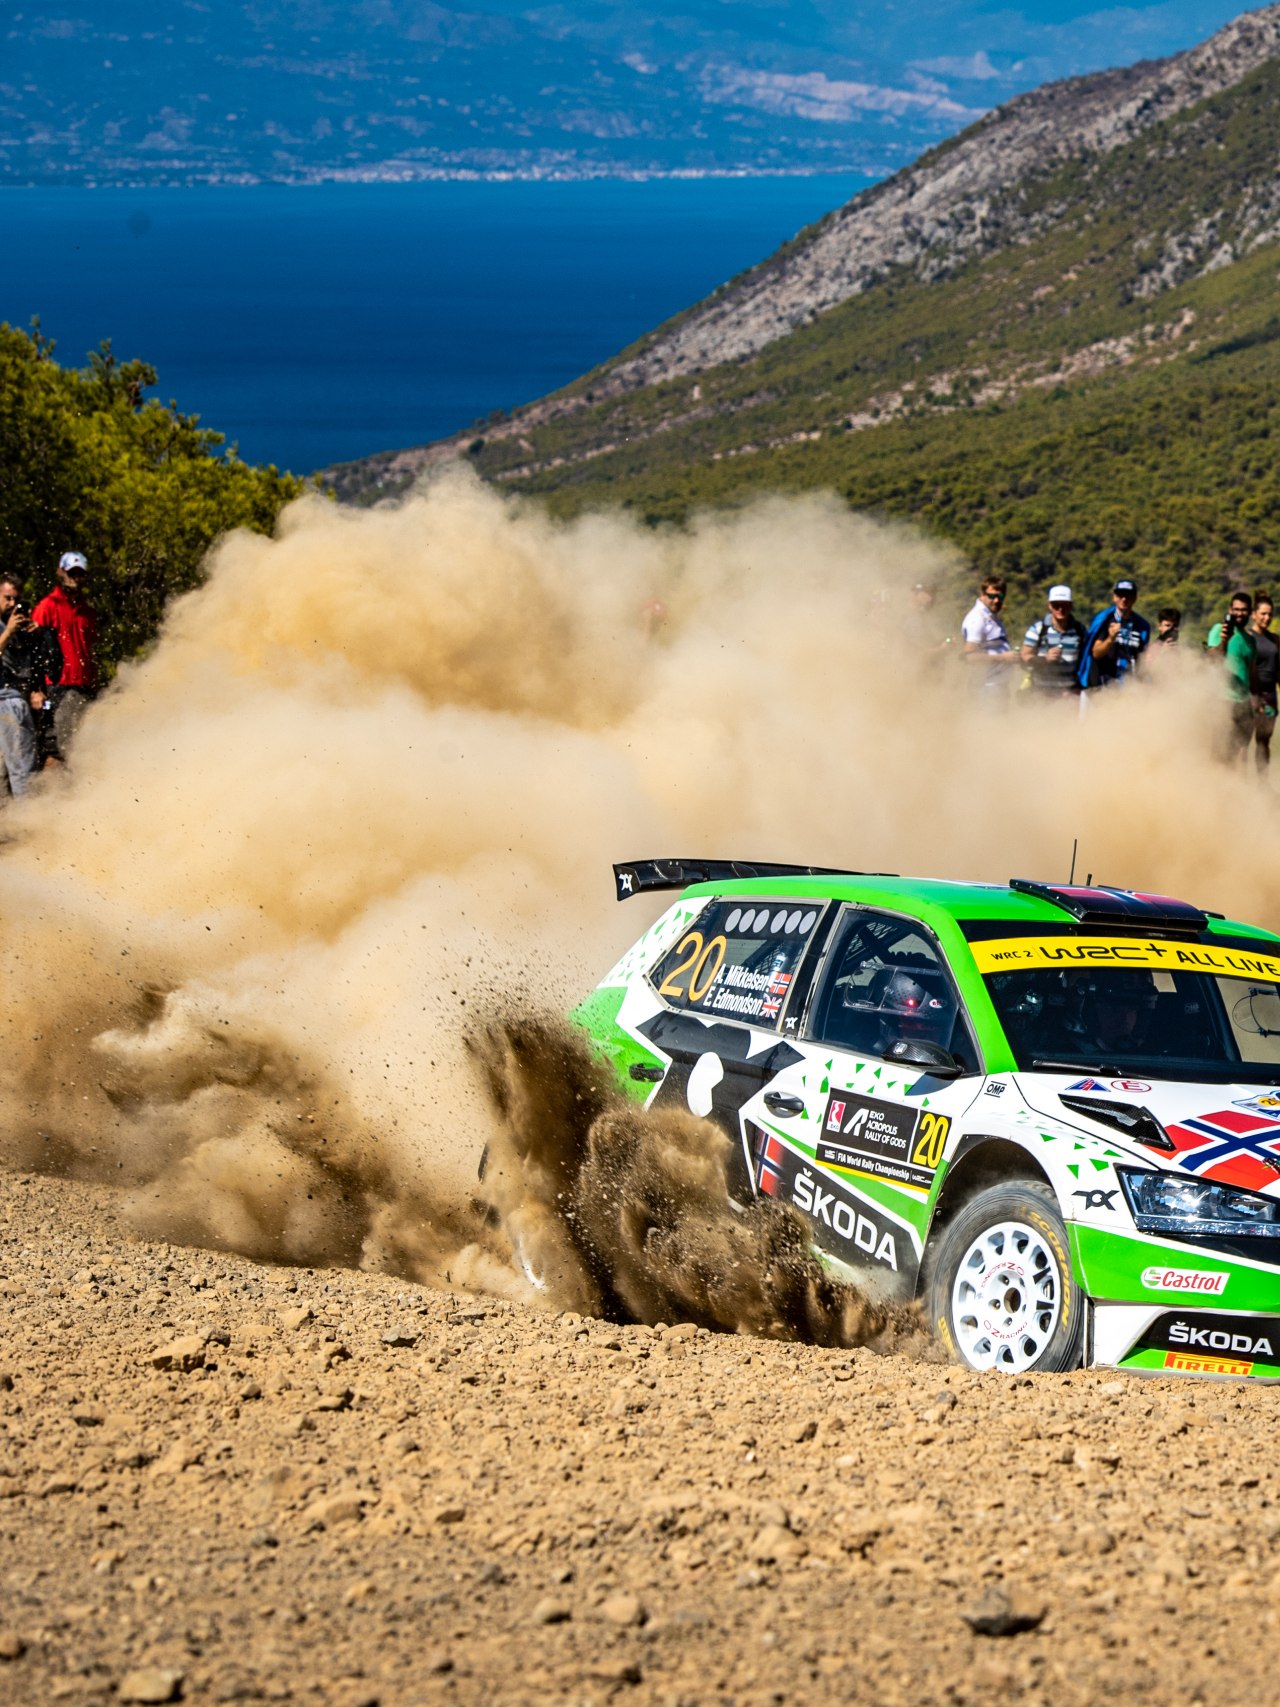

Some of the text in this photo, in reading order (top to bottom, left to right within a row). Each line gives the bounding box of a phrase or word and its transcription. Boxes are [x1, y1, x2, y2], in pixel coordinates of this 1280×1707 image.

[659, 931, 727, 1002] 20
[991, 950, 1033, 960] WRC 2
[1175, 950, 1225, 968] ALL
[713, 963, 769, 992] A. Mikkelsen
[703, 986, 764, 1016] E. Edmondson
[986, 1083, 1006, 1095] OMP
[866, 1120, 899, 1136] ACROPOLIS
[869, 1110, 885, 1121] EKO
[864, 1130, 907, 1149] RALLY OF GODS
[912, 1112, 949, 1169] 20
[838, 1153, 910, 1182] FIA World Rally Championship
[792, 1167, 898, 1272] ŠKODA
[1162, 1271, 1222, 1291] Castrol
[1168, 1321, 1274, 1356] ŠKODA
[1164, 1351, 1253, 1376] PIRELLI
